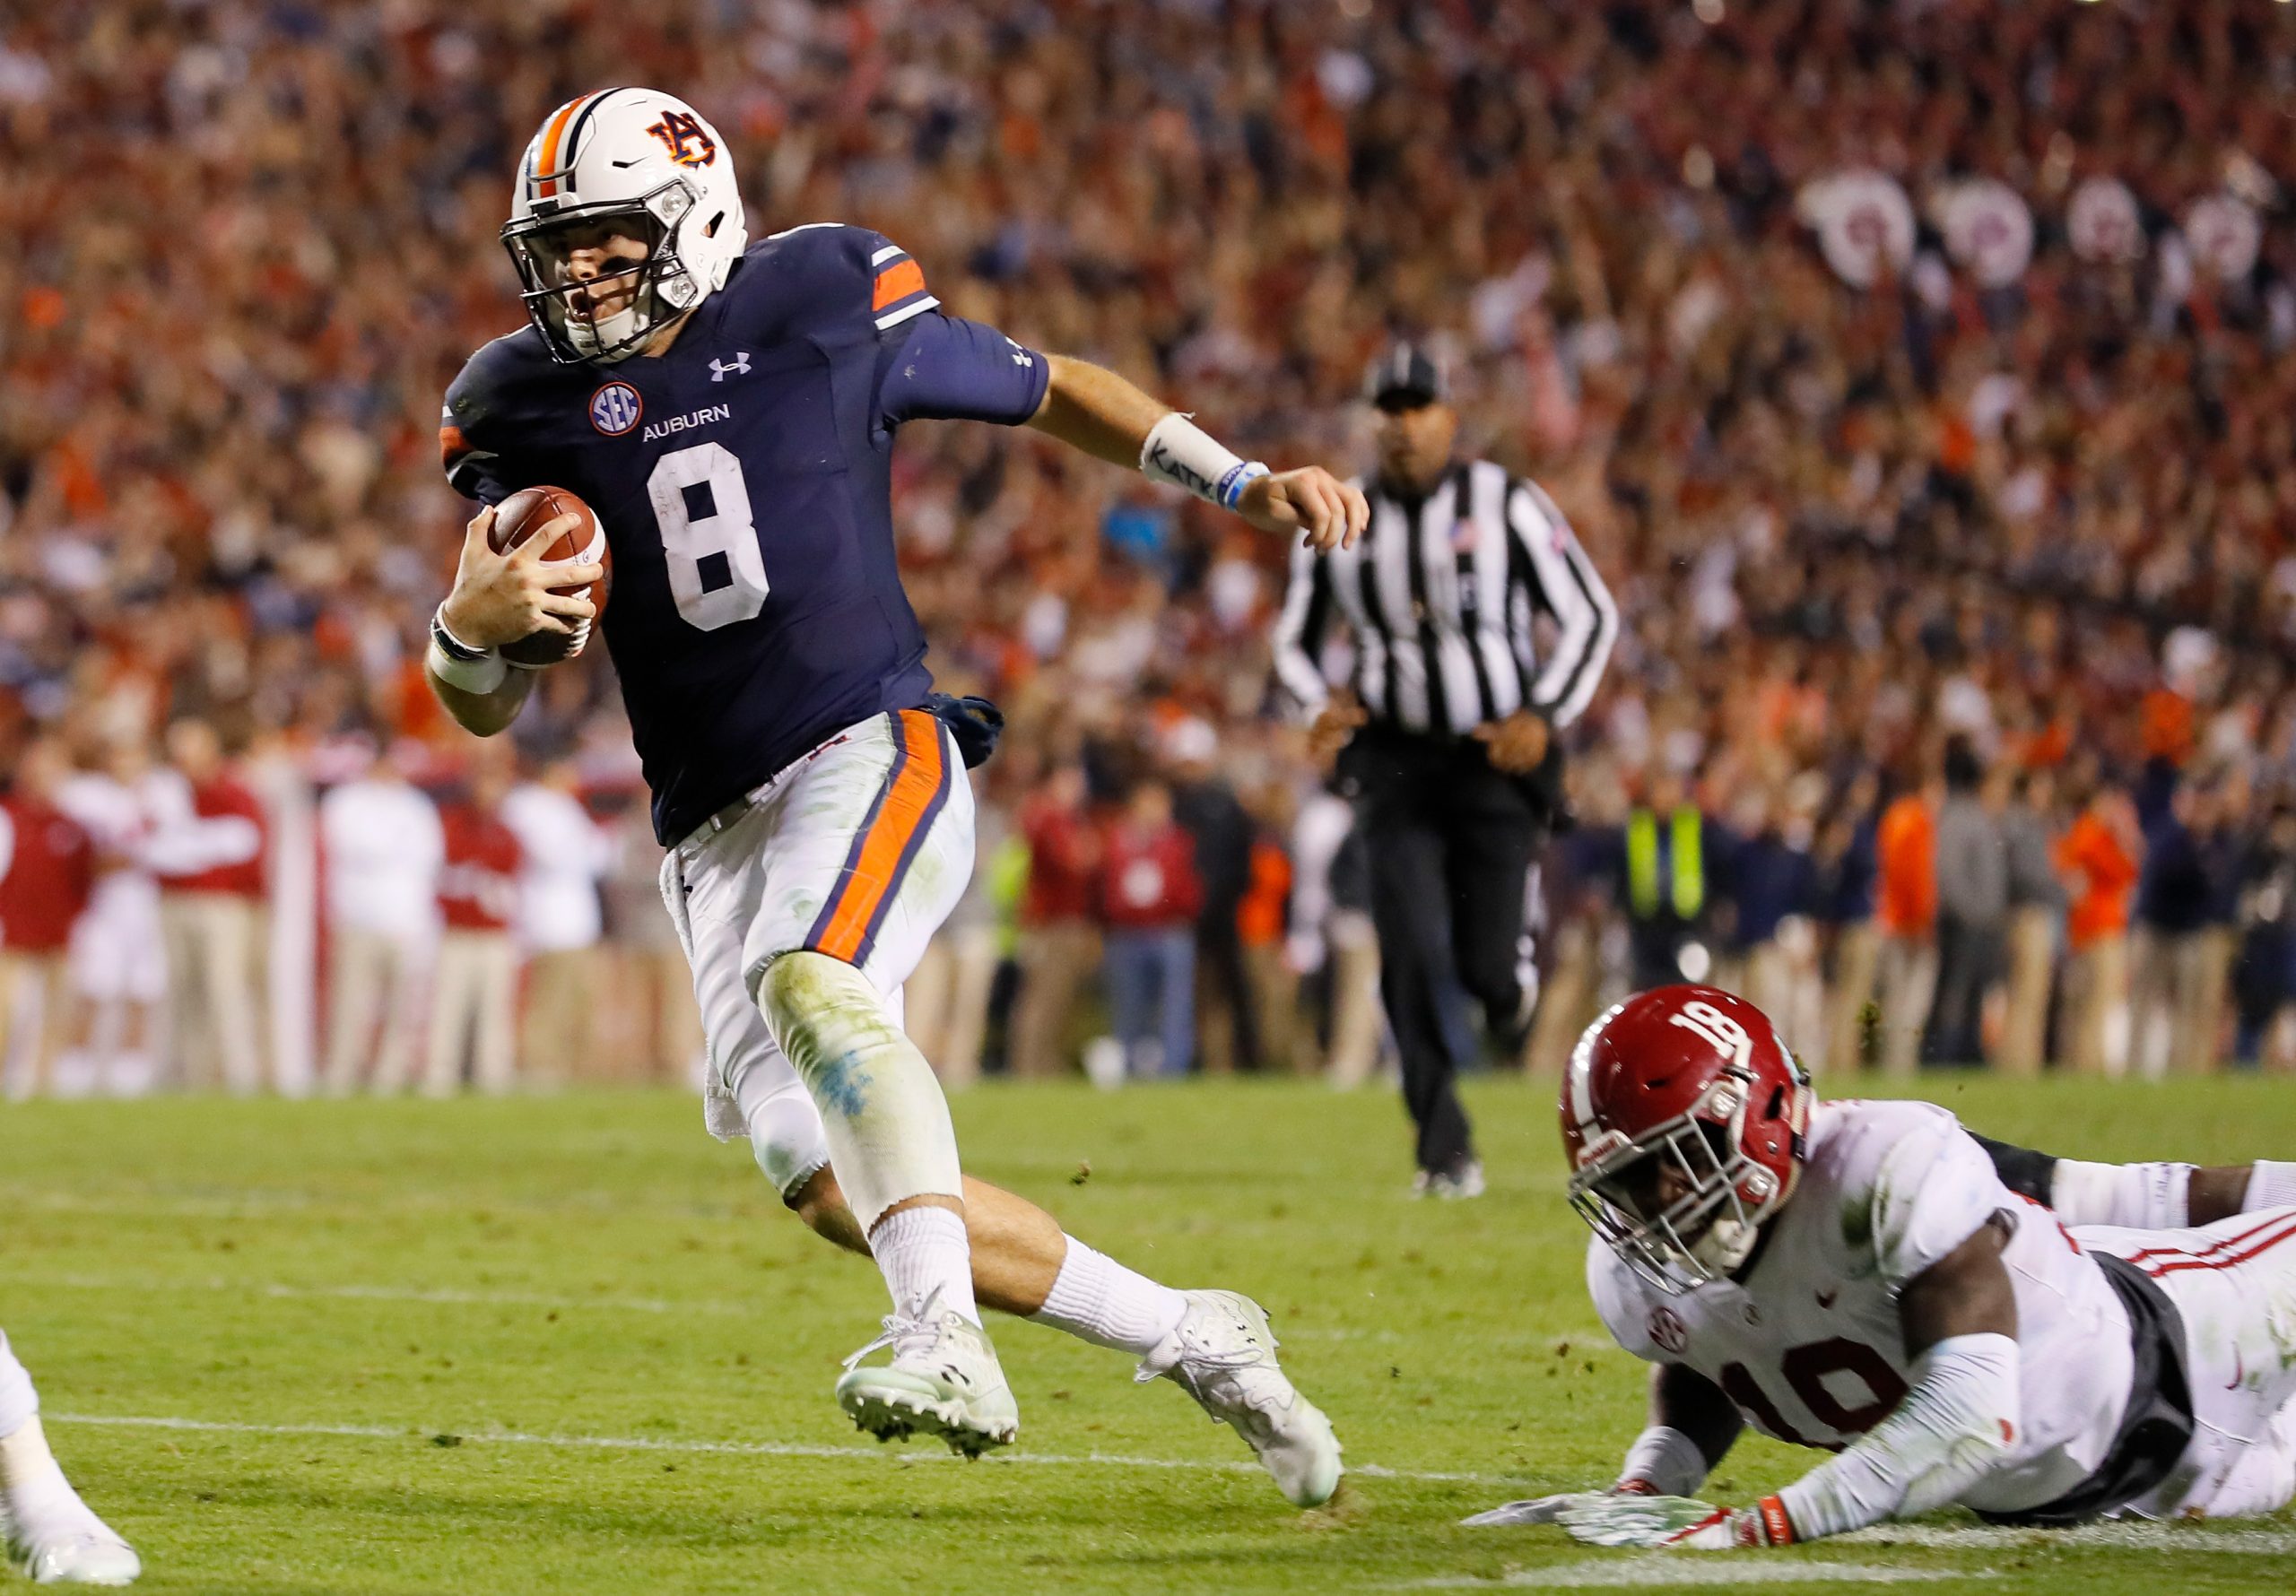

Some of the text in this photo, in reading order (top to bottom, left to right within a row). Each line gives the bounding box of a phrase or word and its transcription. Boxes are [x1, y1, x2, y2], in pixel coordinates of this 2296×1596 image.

[593, 386, 638, 431] SEC
[642, 403, 731, 443] AUBURN
[647, 441, 770, 632] 8
[1668, 1001, 1749, 1060] 18
